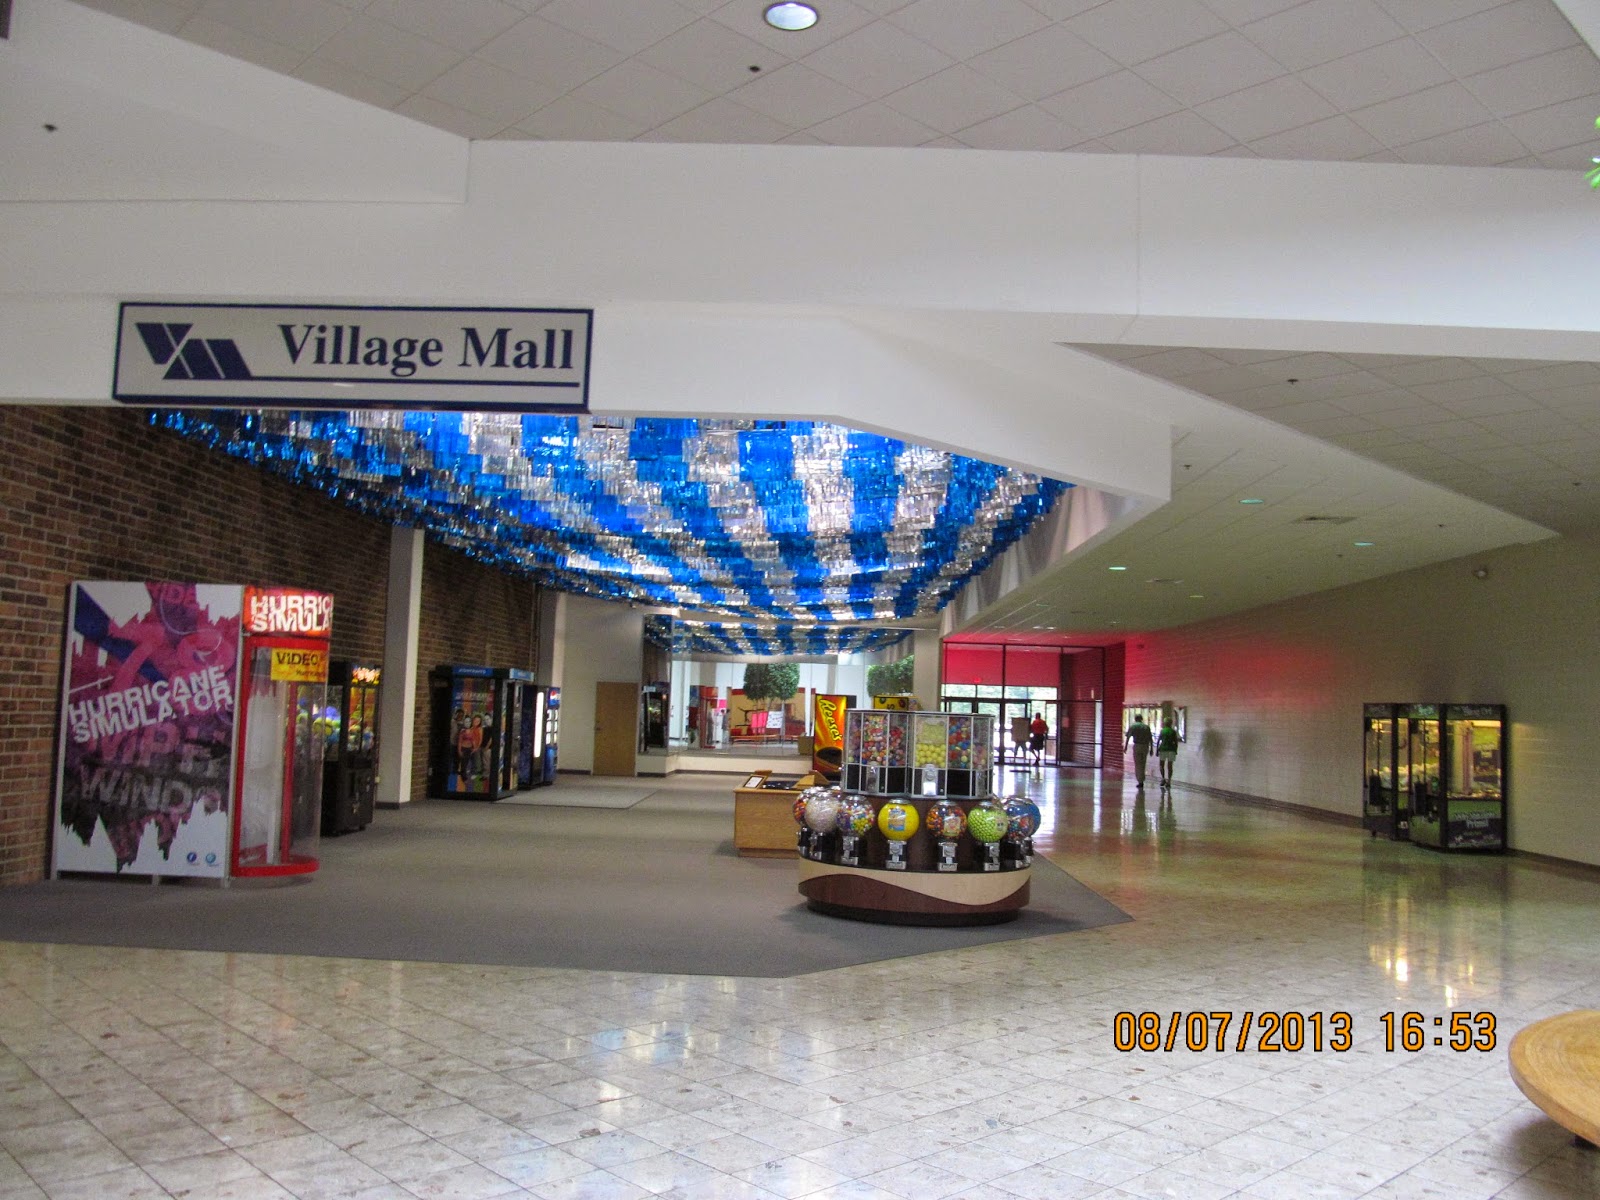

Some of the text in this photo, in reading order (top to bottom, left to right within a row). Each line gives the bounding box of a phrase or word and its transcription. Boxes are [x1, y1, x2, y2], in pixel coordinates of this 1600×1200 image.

[278, 323, 574, 377] Village Mall
[68, 664, 226, 726] HURRICANE
[73, 679, 233, 744] SIMULATOR
[819, 698, 843, 741] Reese's
